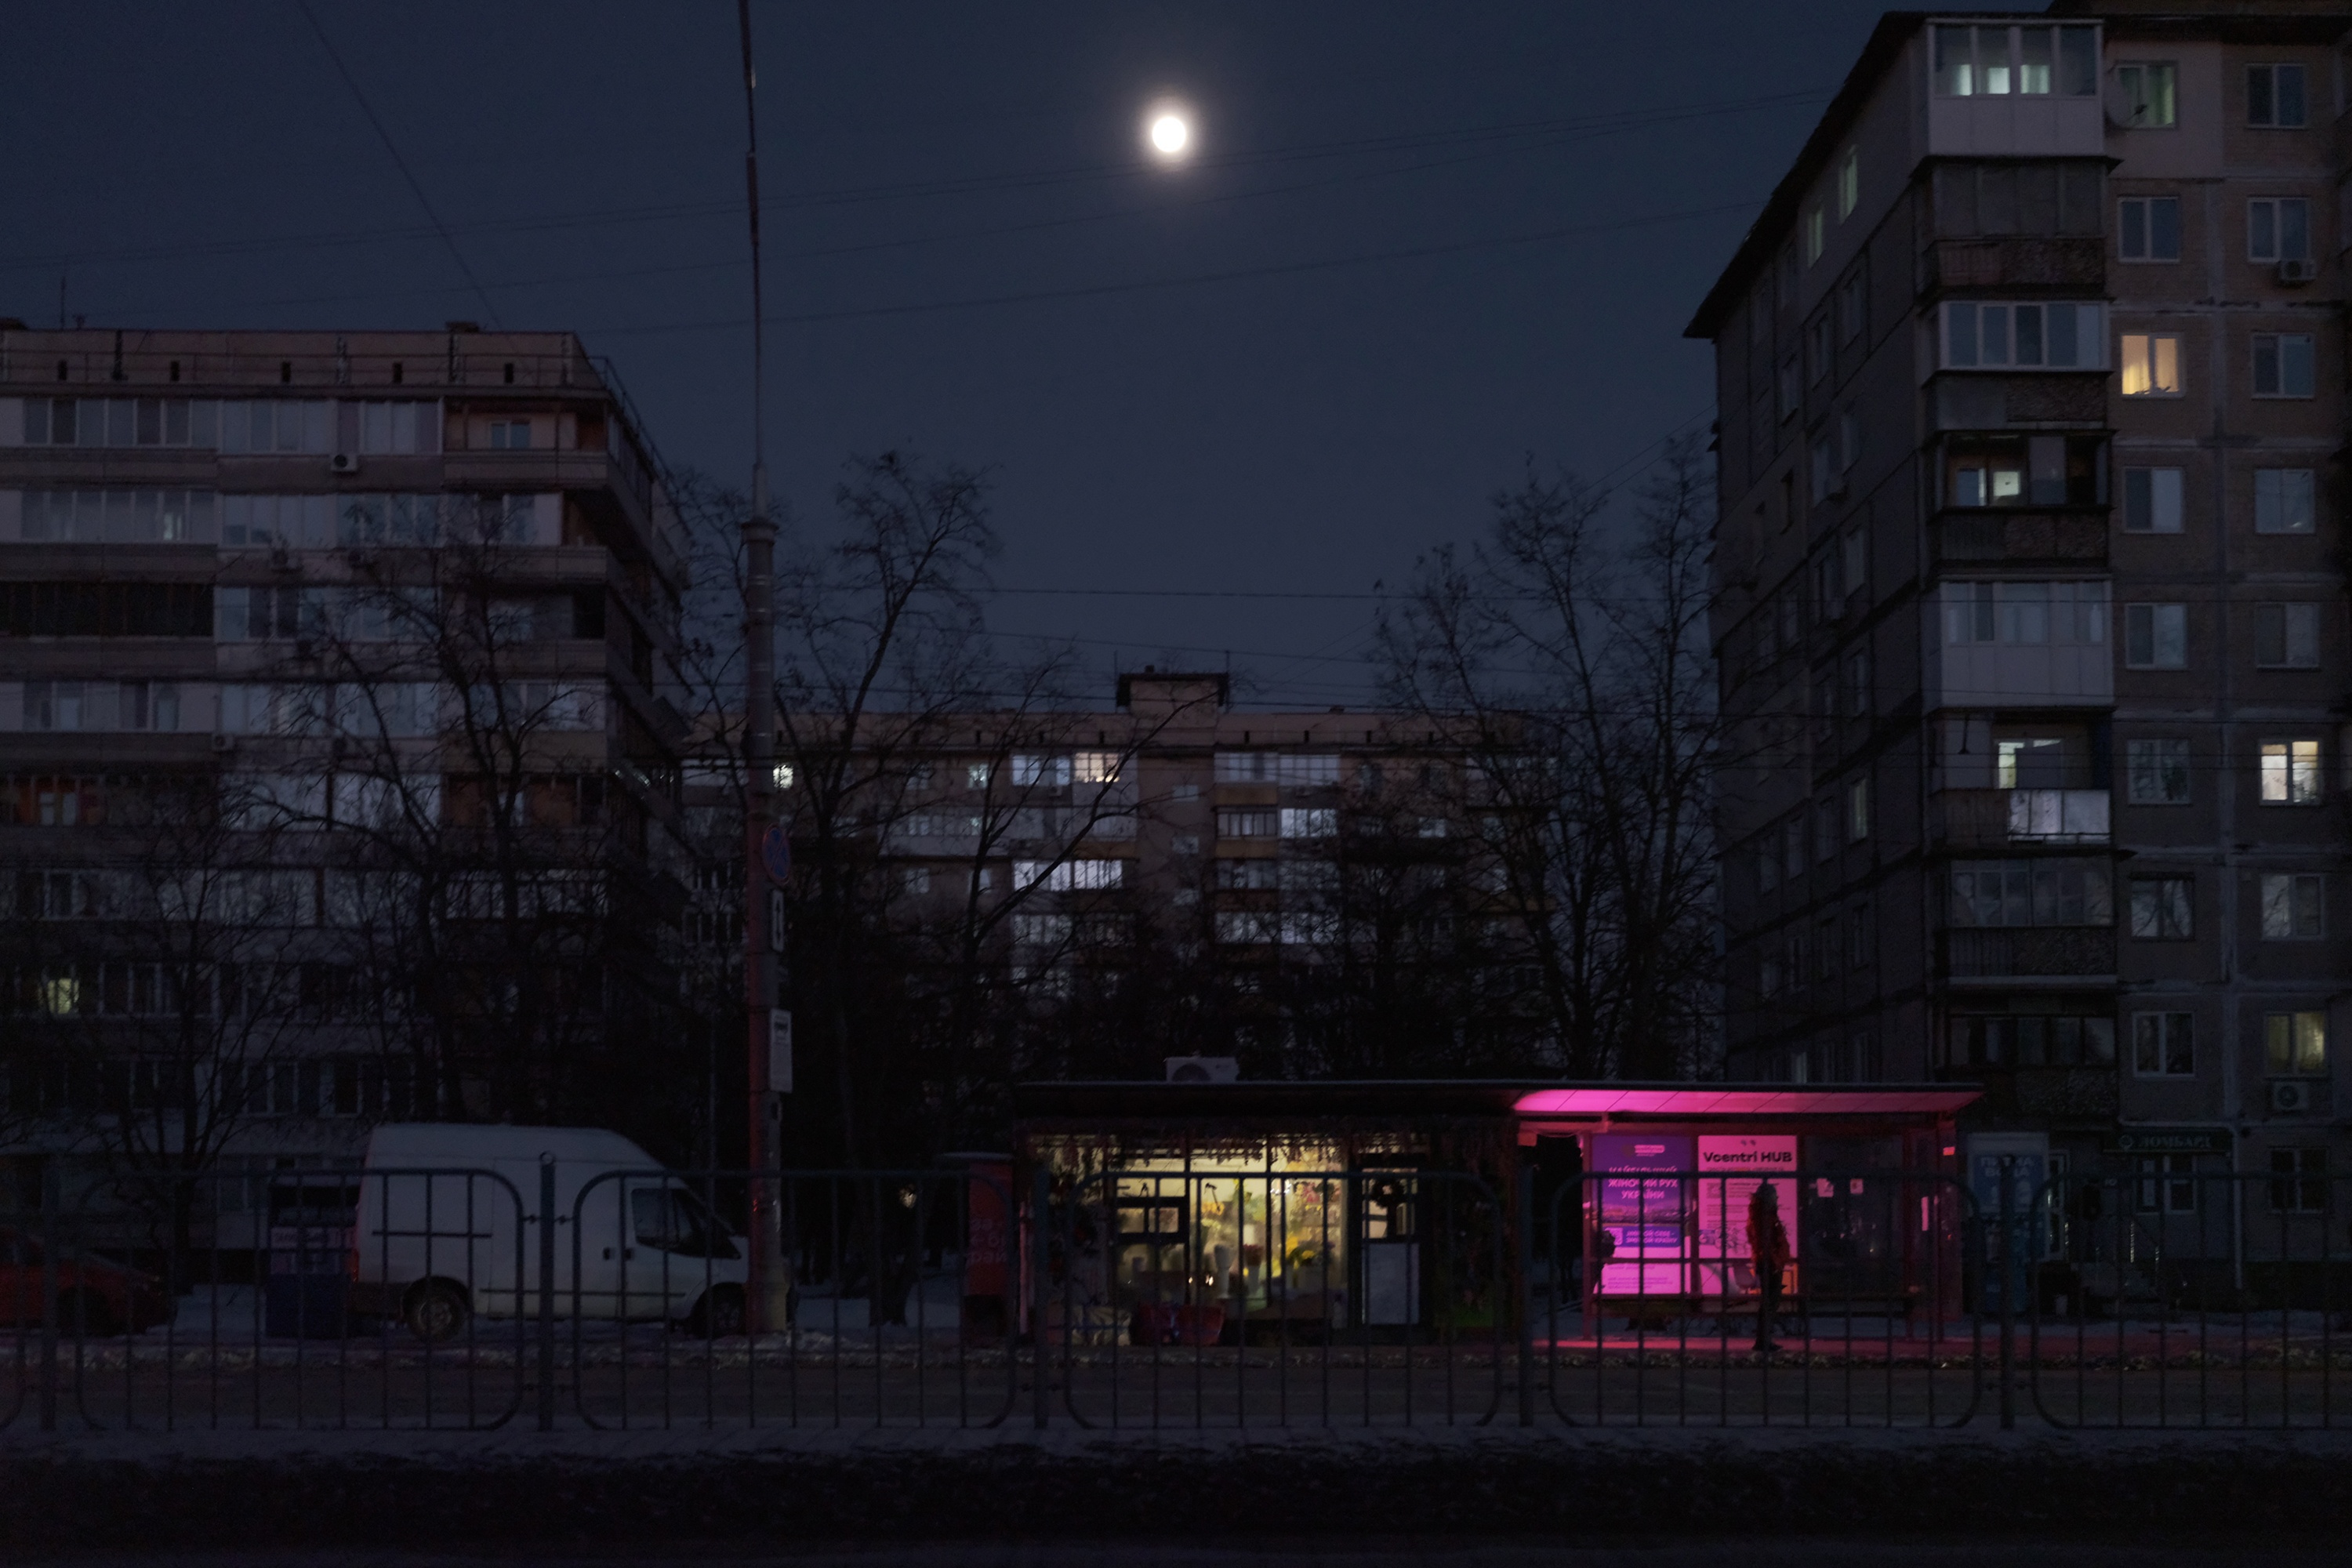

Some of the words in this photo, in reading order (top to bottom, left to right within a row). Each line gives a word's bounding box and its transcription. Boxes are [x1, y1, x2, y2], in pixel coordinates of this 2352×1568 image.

[2139, 1135, 2212, 1148] ЛОМБАРД
[1704, 1151, 1757, 1162] Vcentri
[1761, 1151, 1792, 1162] HUB
[1659, 1178, 1679, 1188] РУХ
